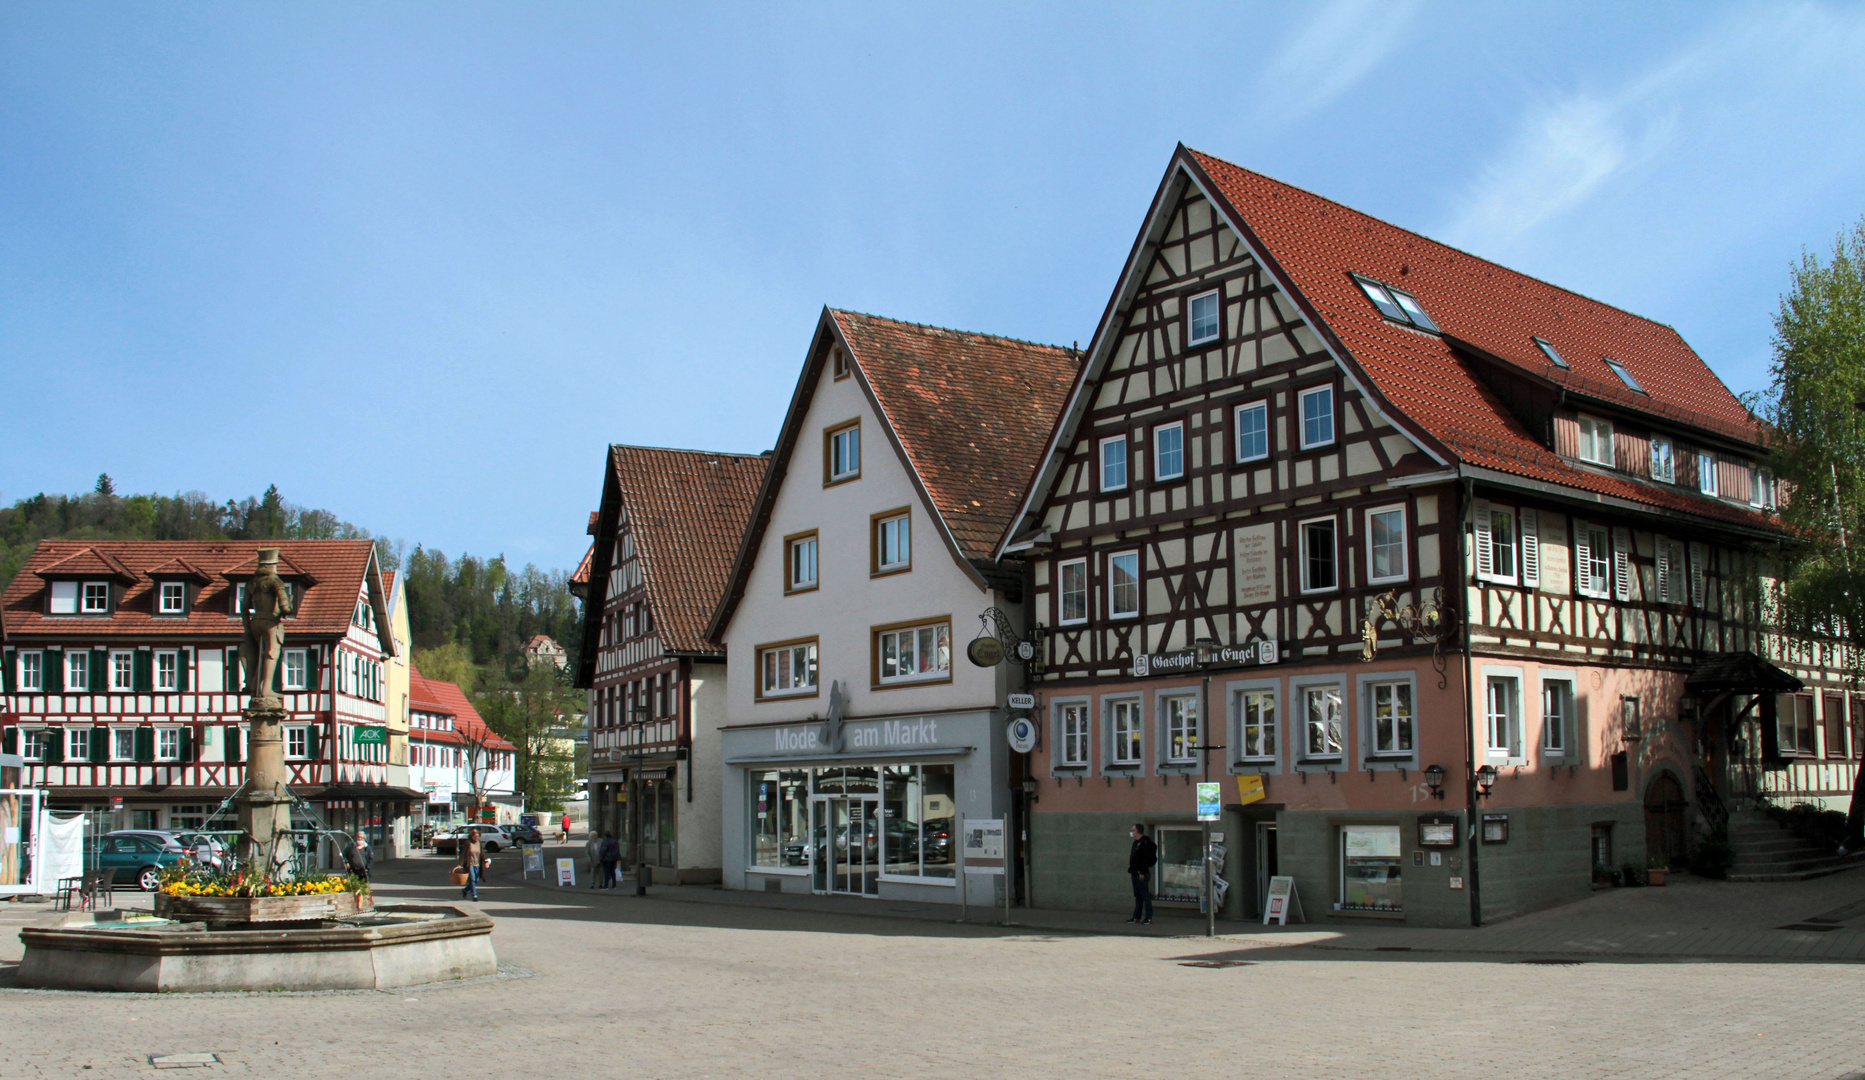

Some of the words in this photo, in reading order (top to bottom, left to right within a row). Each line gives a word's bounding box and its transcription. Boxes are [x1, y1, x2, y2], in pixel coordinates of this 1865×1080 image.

[1152, 652, 1194, 669] Gasthof
[1221, 645, 1254, 663] Engel
[1011, 697, 1032, 705] KELLER
[359, 729, 381, 739] AOK
[775, 726, 816, 751] Mode
[854, 725, 879, 747] am
[884, 717, 937, 746] Markt
[1409, 782, 1429, 804] 15
